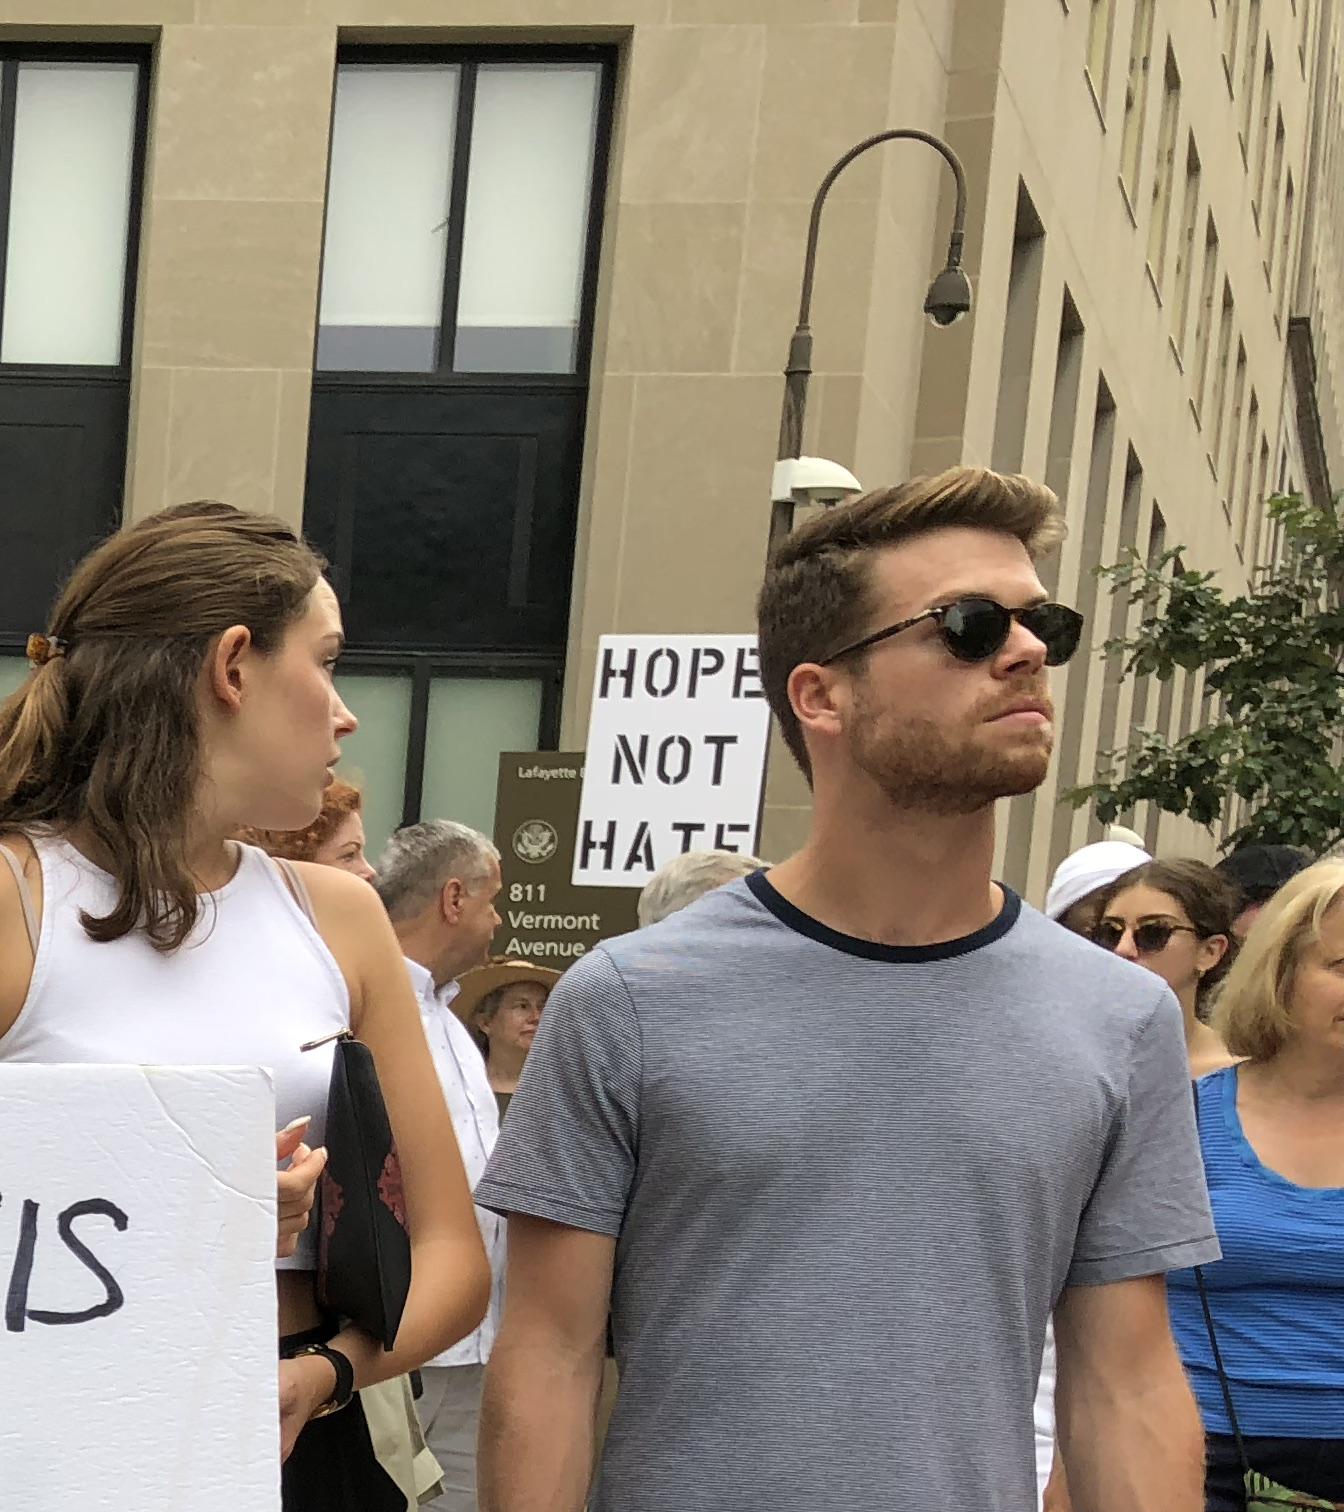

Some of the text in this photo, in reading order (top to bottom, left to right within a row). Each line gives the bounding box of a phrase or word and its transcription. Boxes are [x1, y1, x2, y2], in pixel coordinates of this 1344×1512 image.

[598, 647, 769, 699] HOPE
[611, 734, 738, 787] NOT
[517, 765, 577, 781] Lafayette
[508, 882, 546, 902] 811
[507, 910, 600, 931] Vermont
[504, 937, 586, 957] Avenue
